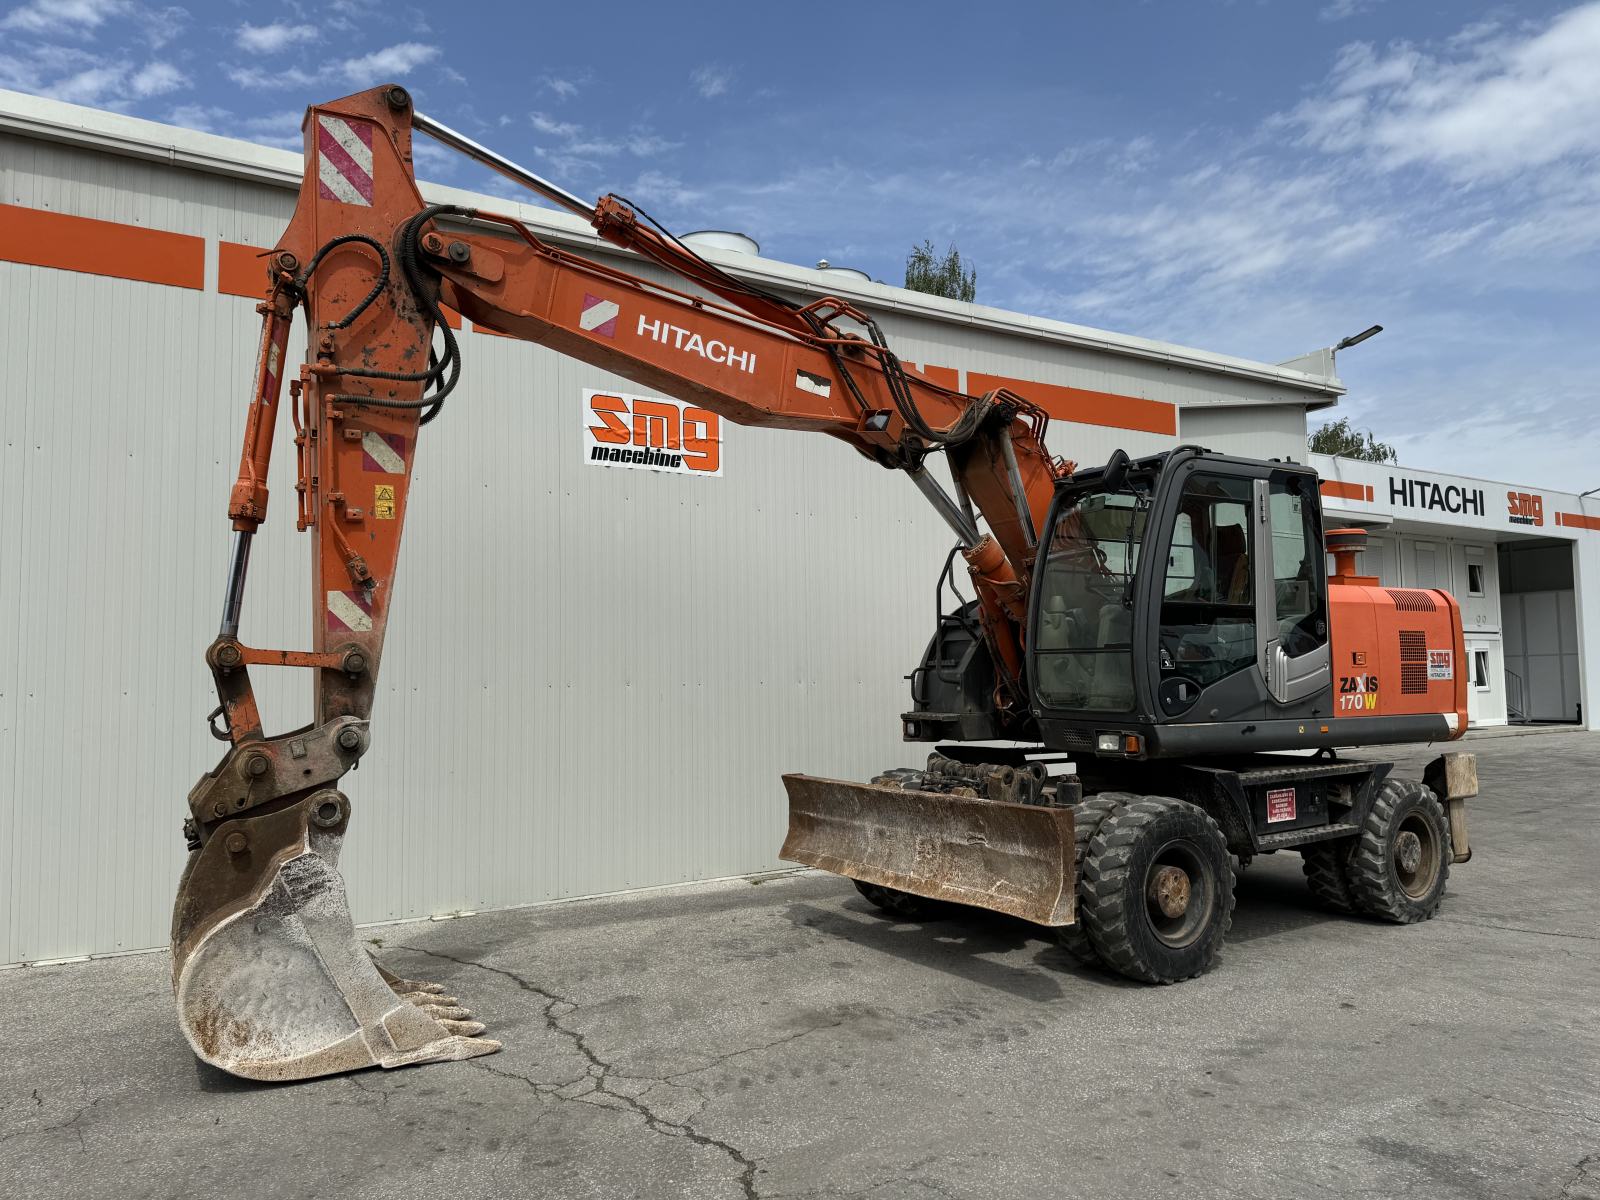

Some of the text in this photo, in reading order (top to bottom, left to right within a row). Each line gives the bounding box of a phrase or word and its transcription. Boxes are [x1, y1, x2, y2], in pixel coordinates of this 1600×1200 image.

[637, 314, 756, 374] HITACHI
[588, 394, 719, 472] smg
[591, 446, 682, 468] macchine
[1389, 477, 1485, 516] HITACHI
[1507, 491, 1544, 527] smg
[1340, 673, 1378, 693] ZAXIS
[1340, 693, 1377, 710] 170W
